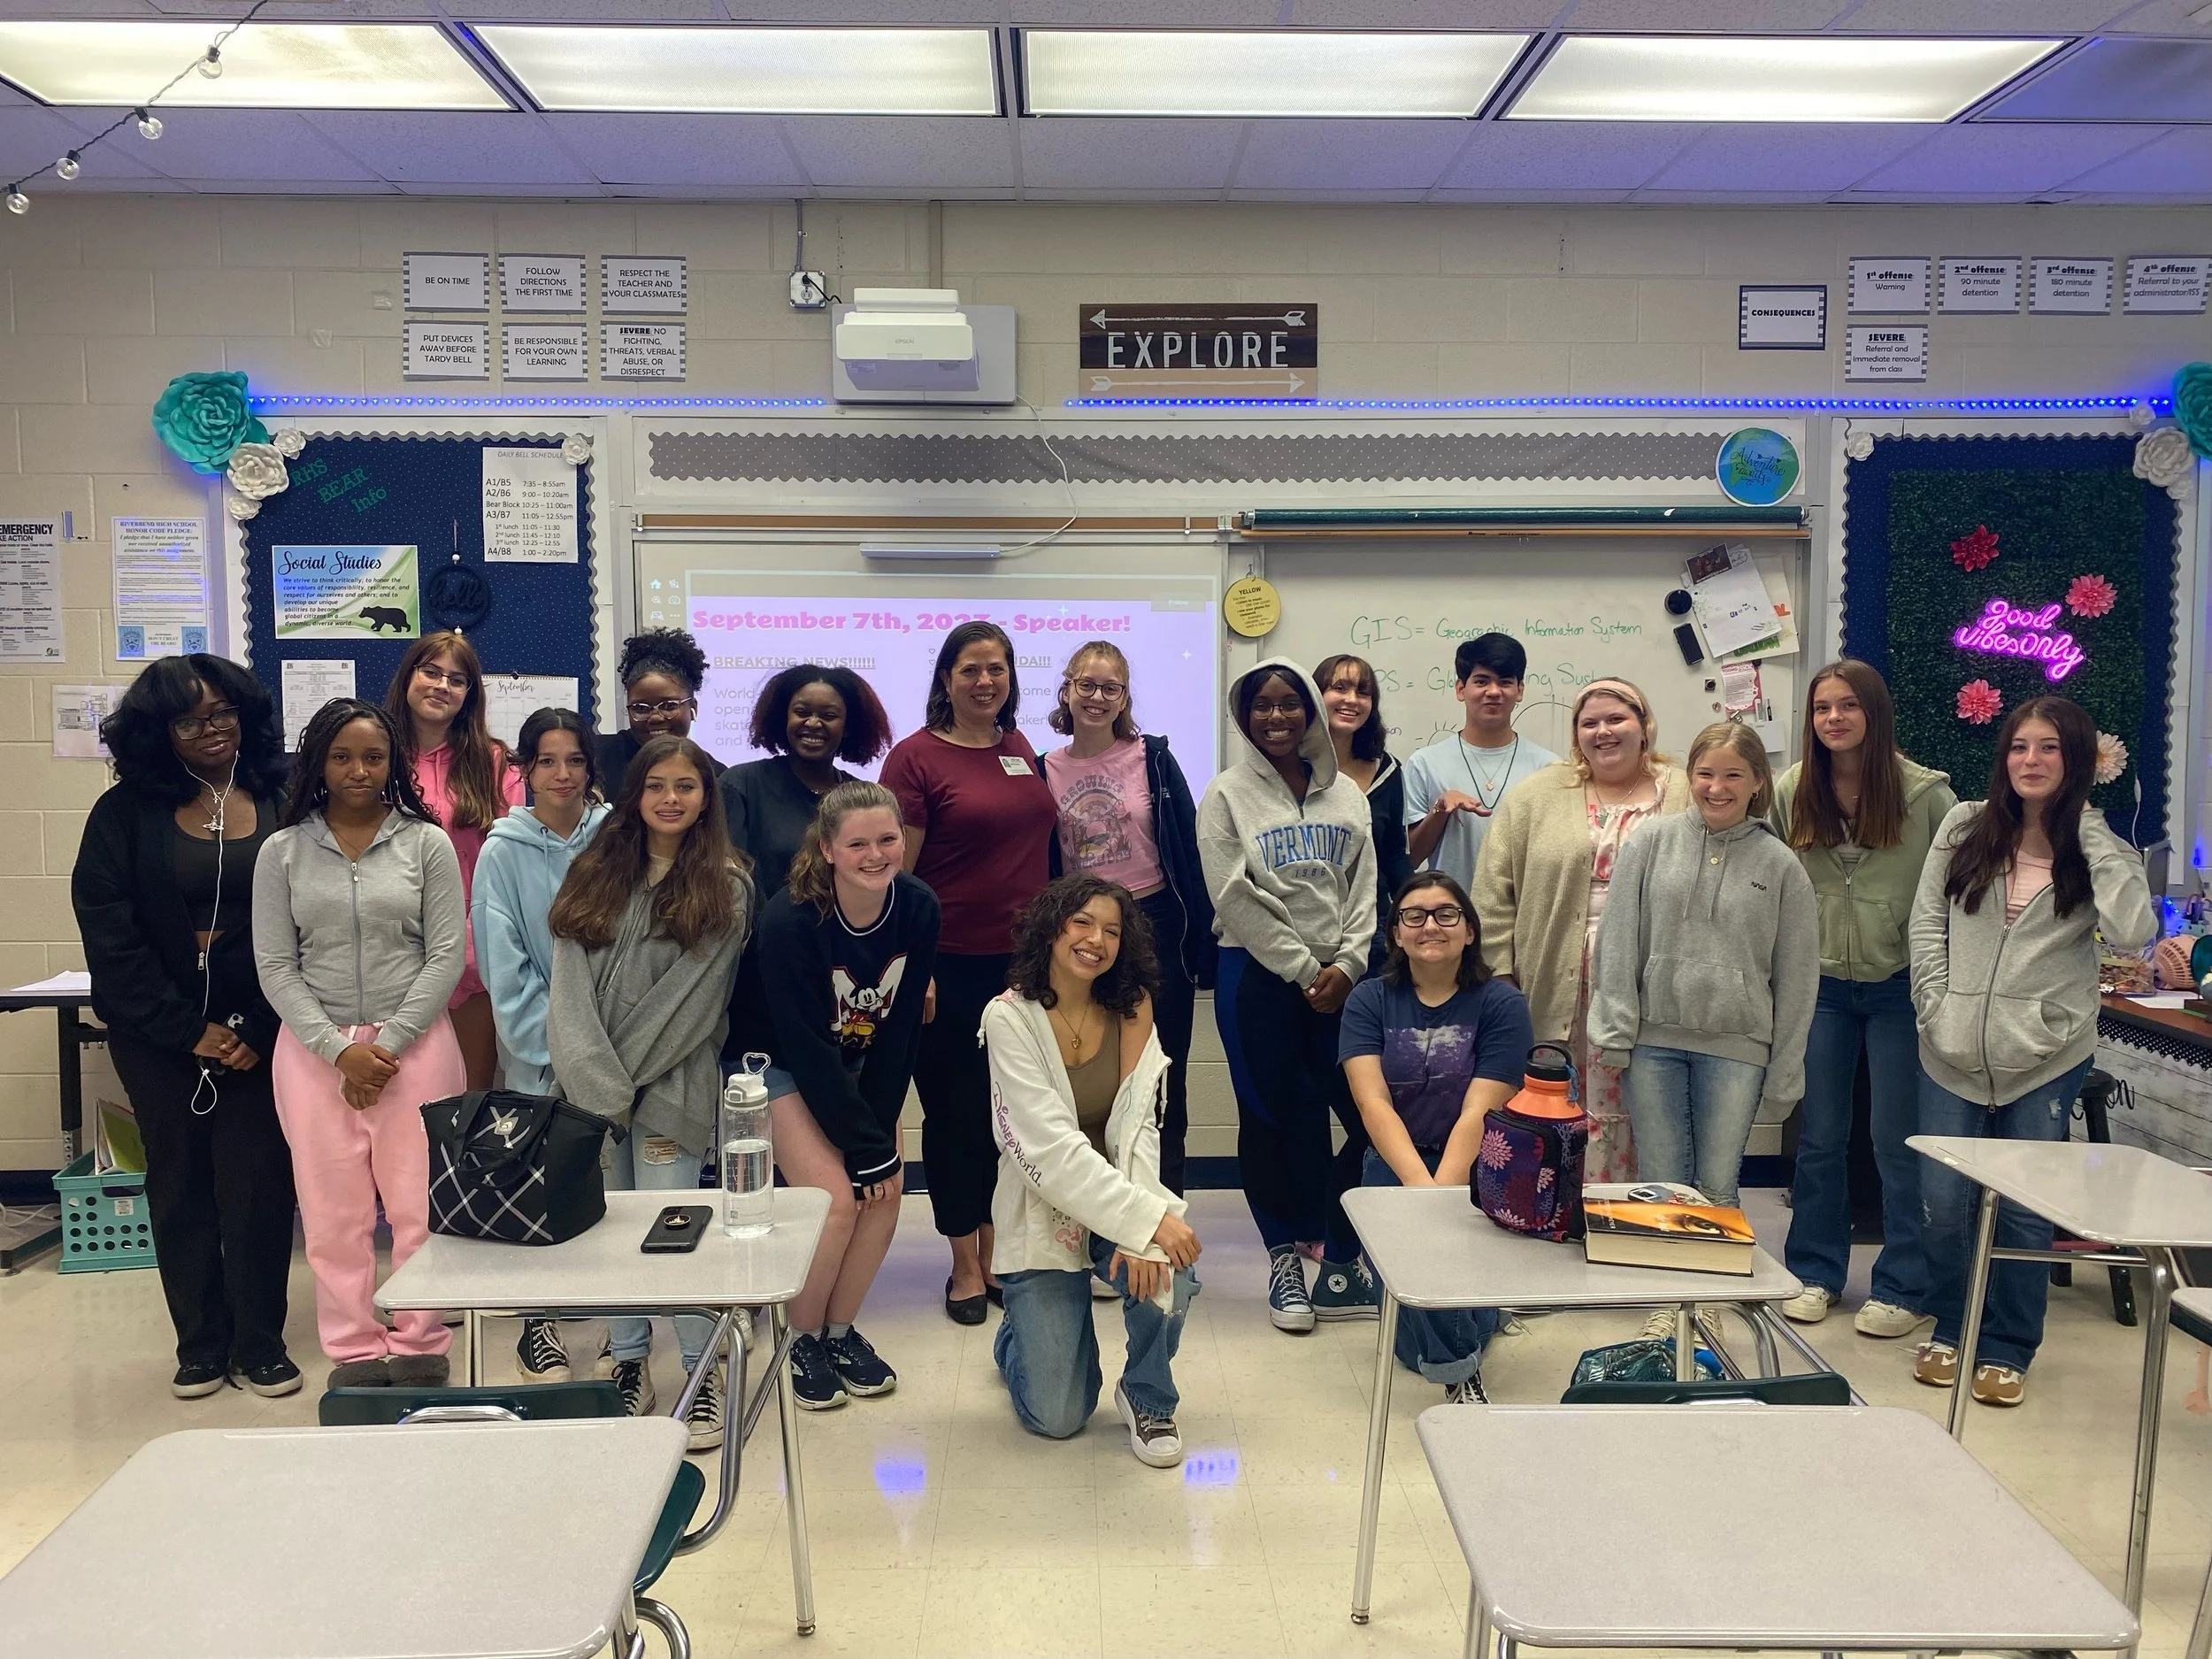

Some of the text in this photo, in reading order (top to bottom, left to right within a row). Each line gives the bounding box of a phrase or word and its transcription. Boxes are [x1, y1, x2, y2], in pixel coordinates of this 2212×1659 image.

[1955, 265, 1969, 274] 2nd
[2047, 265, 2059, 274] 3rd
[2144, 265, 2158, 273] 4th
[424, 334, 473, 343] PUT DEVICES
[1107, 331, 1289, 369] EXPLORE
[290, 458, 327, 487] RHS
[318, 467, 369, 503] BEAR
[486, 478, 511, 487] A1/B5
[278, 551, 381, 574] Social Studies
[693, 611, 847, 631] September
[852, 612, 910, 634] 7th,
[1013, 614, 1131, 634] Speaker!
[1525, 618, 1585, 637] Information
[1590, 616, 1642, 643] System
[713, 657, 797, 668] BREAKING
[497, 680, 534, 695] September
[1256, 824, 1351, 872] VERMONT
[1295, 867, 1326, 878] 1986
